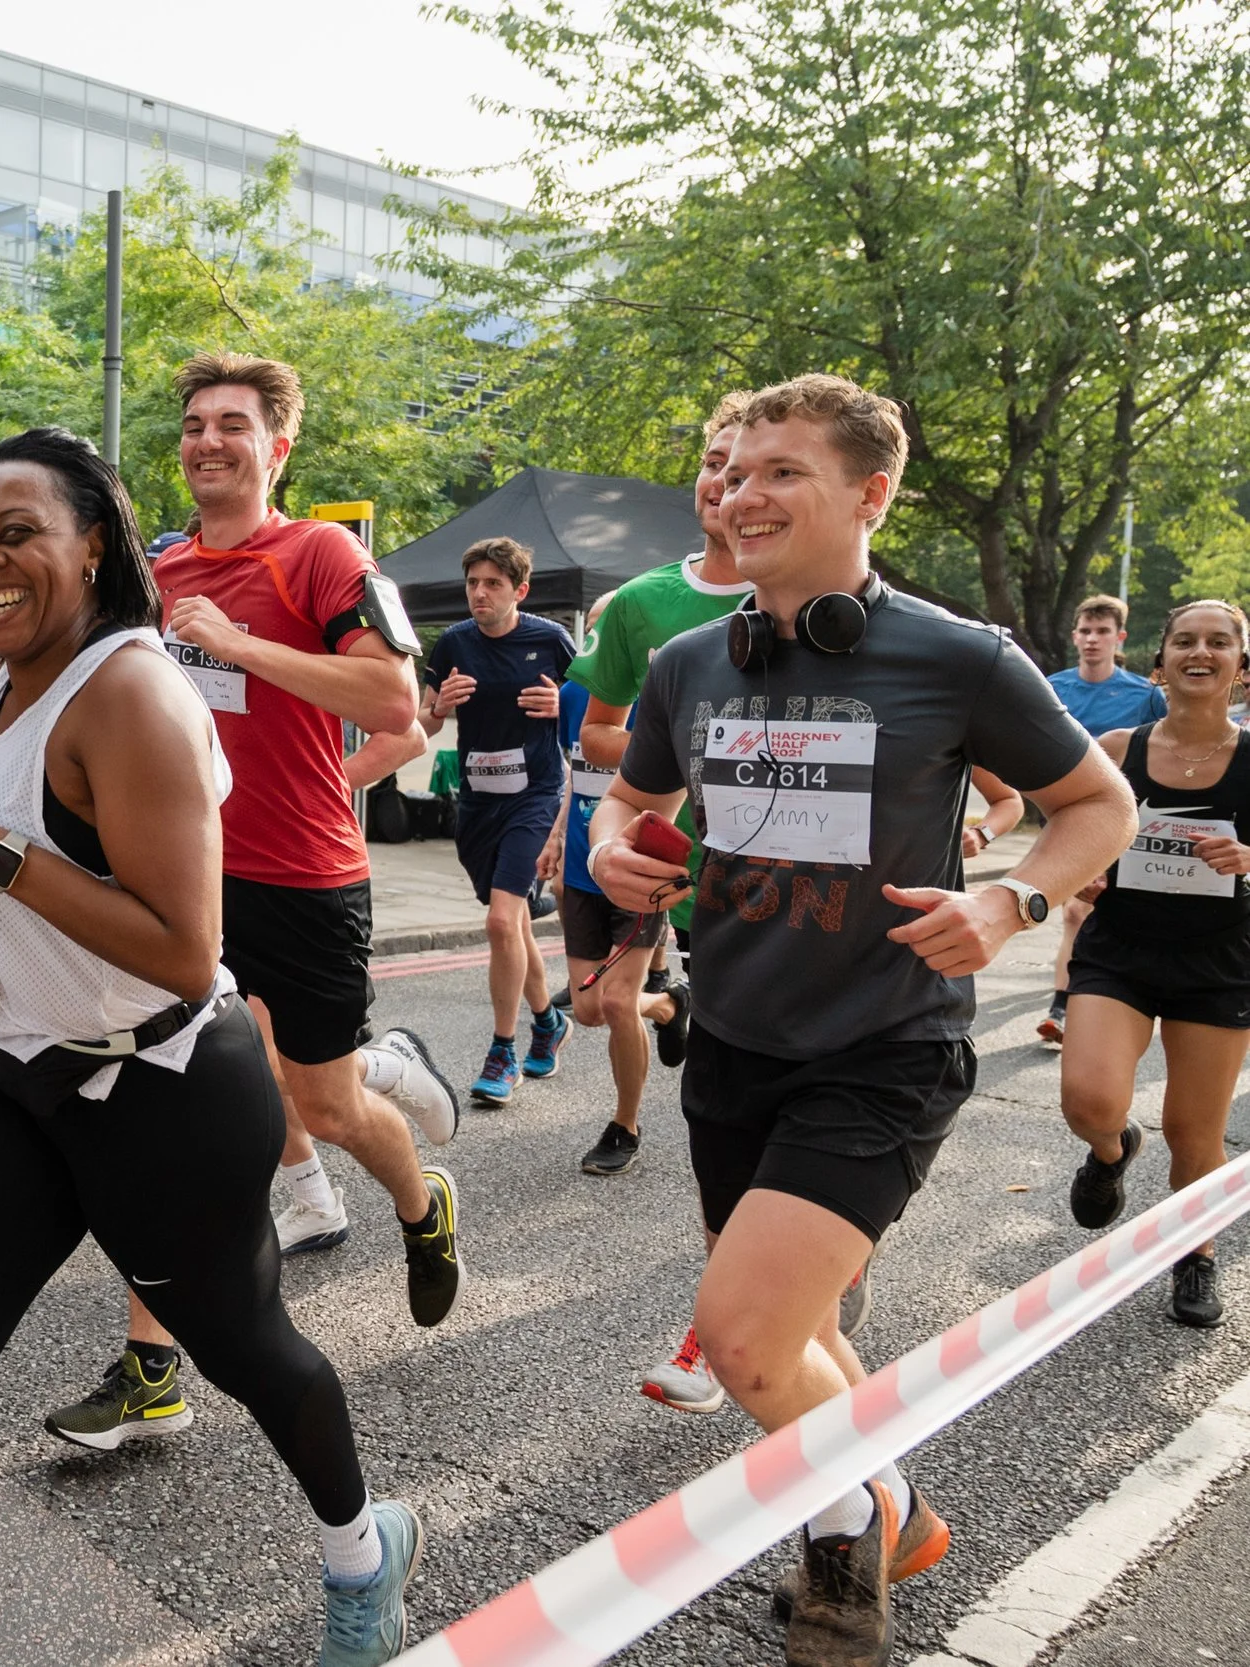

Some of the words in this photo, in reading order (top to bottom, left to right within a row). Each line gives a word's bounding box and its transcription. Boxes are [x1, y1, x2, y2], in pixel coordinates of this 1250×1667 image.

[181, 647, 194, 664] C
[771, 732, 843, 742] HACKNEY
[771, 740, 809, 749] HALF
[771, 749, 803, 758] 2021
[490, 764, 520, 776] 13225
[735, 762, 755, 785] C
[763, 763, 829, 788] 7614
[725, 803, 829, 833] TOMMY
[1172, 823, 1218, 832] HACKNEY
[1150, 838, 1164, 852] D
